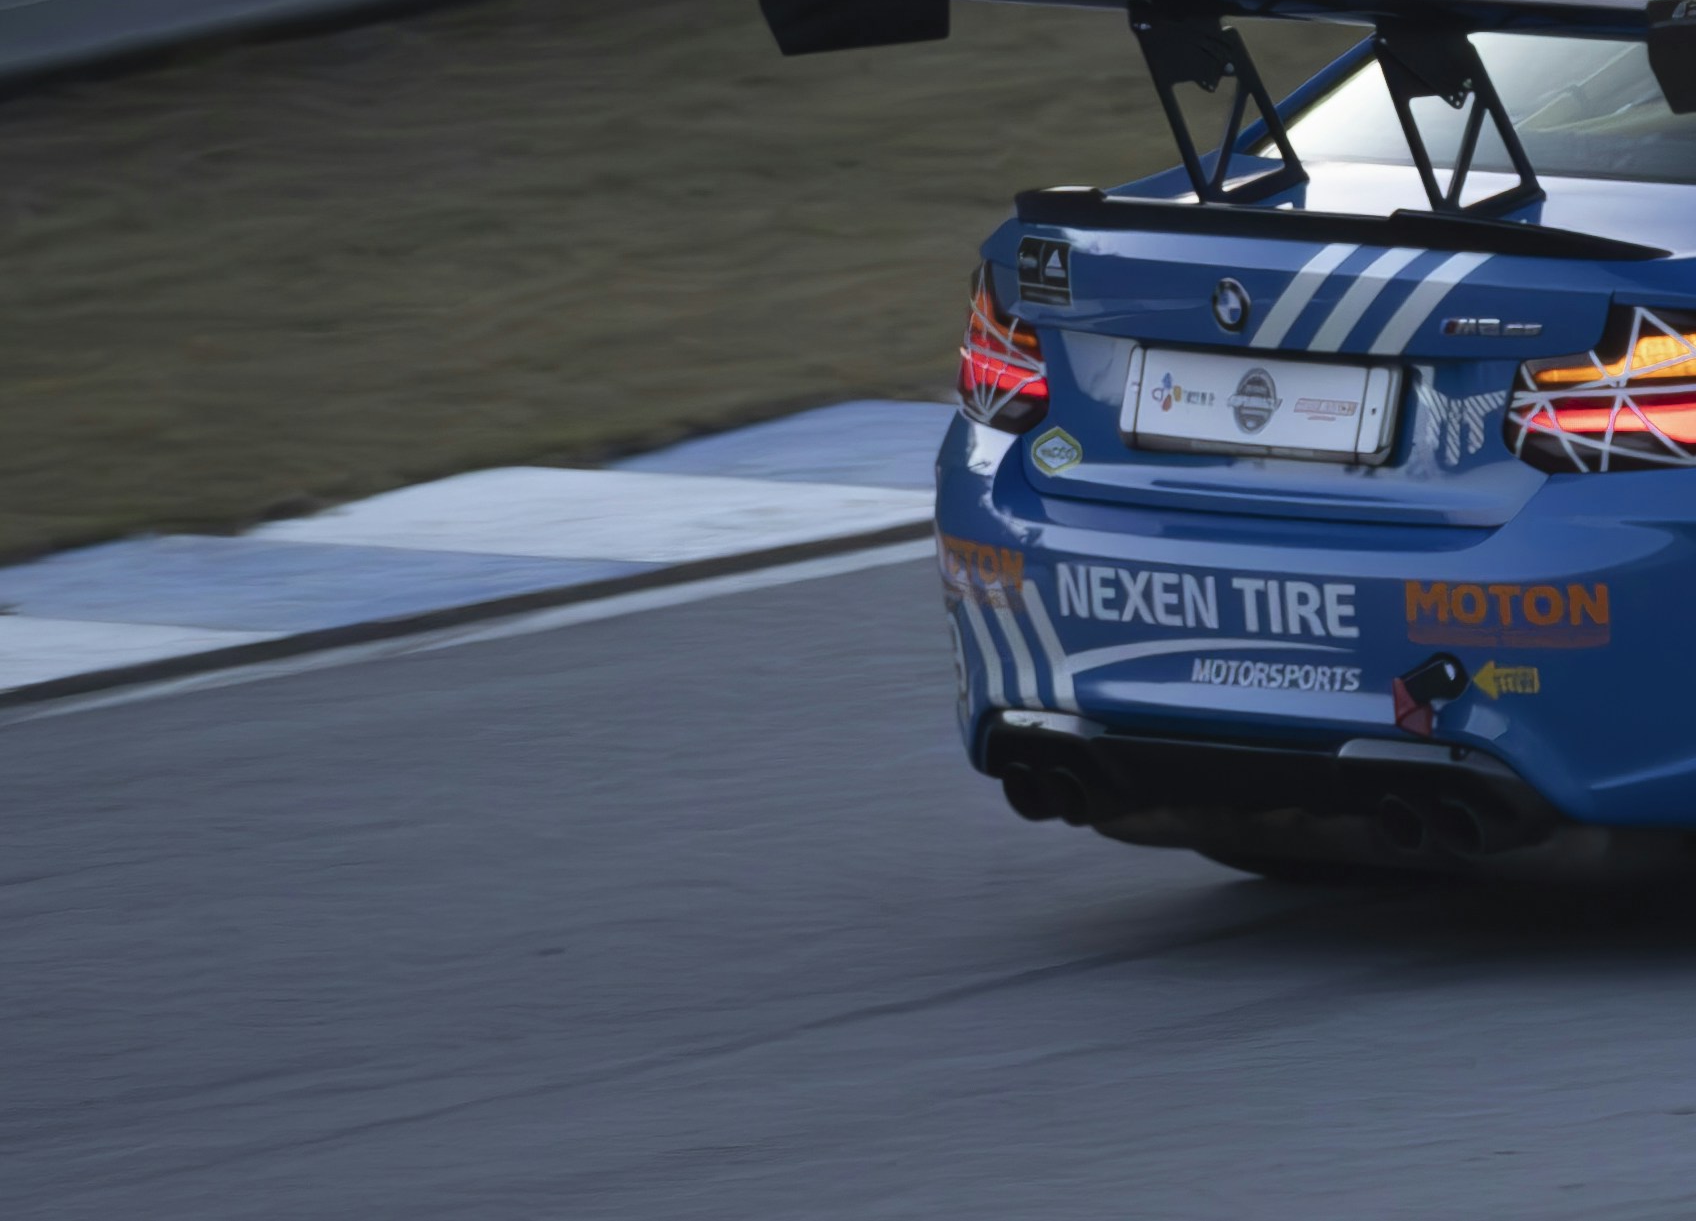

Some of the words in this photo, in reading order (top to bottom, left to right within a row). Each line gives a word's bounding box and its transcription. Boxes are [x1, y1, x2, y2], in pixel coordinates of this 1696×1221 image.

[1056, 563, 1219, 630] NEXEN
[1231, 577, 1360, 638] TIRE
[1405, 580, 1609, 626] MOTON
[1191, 658, 1362, 691] MOTORSPORTS
